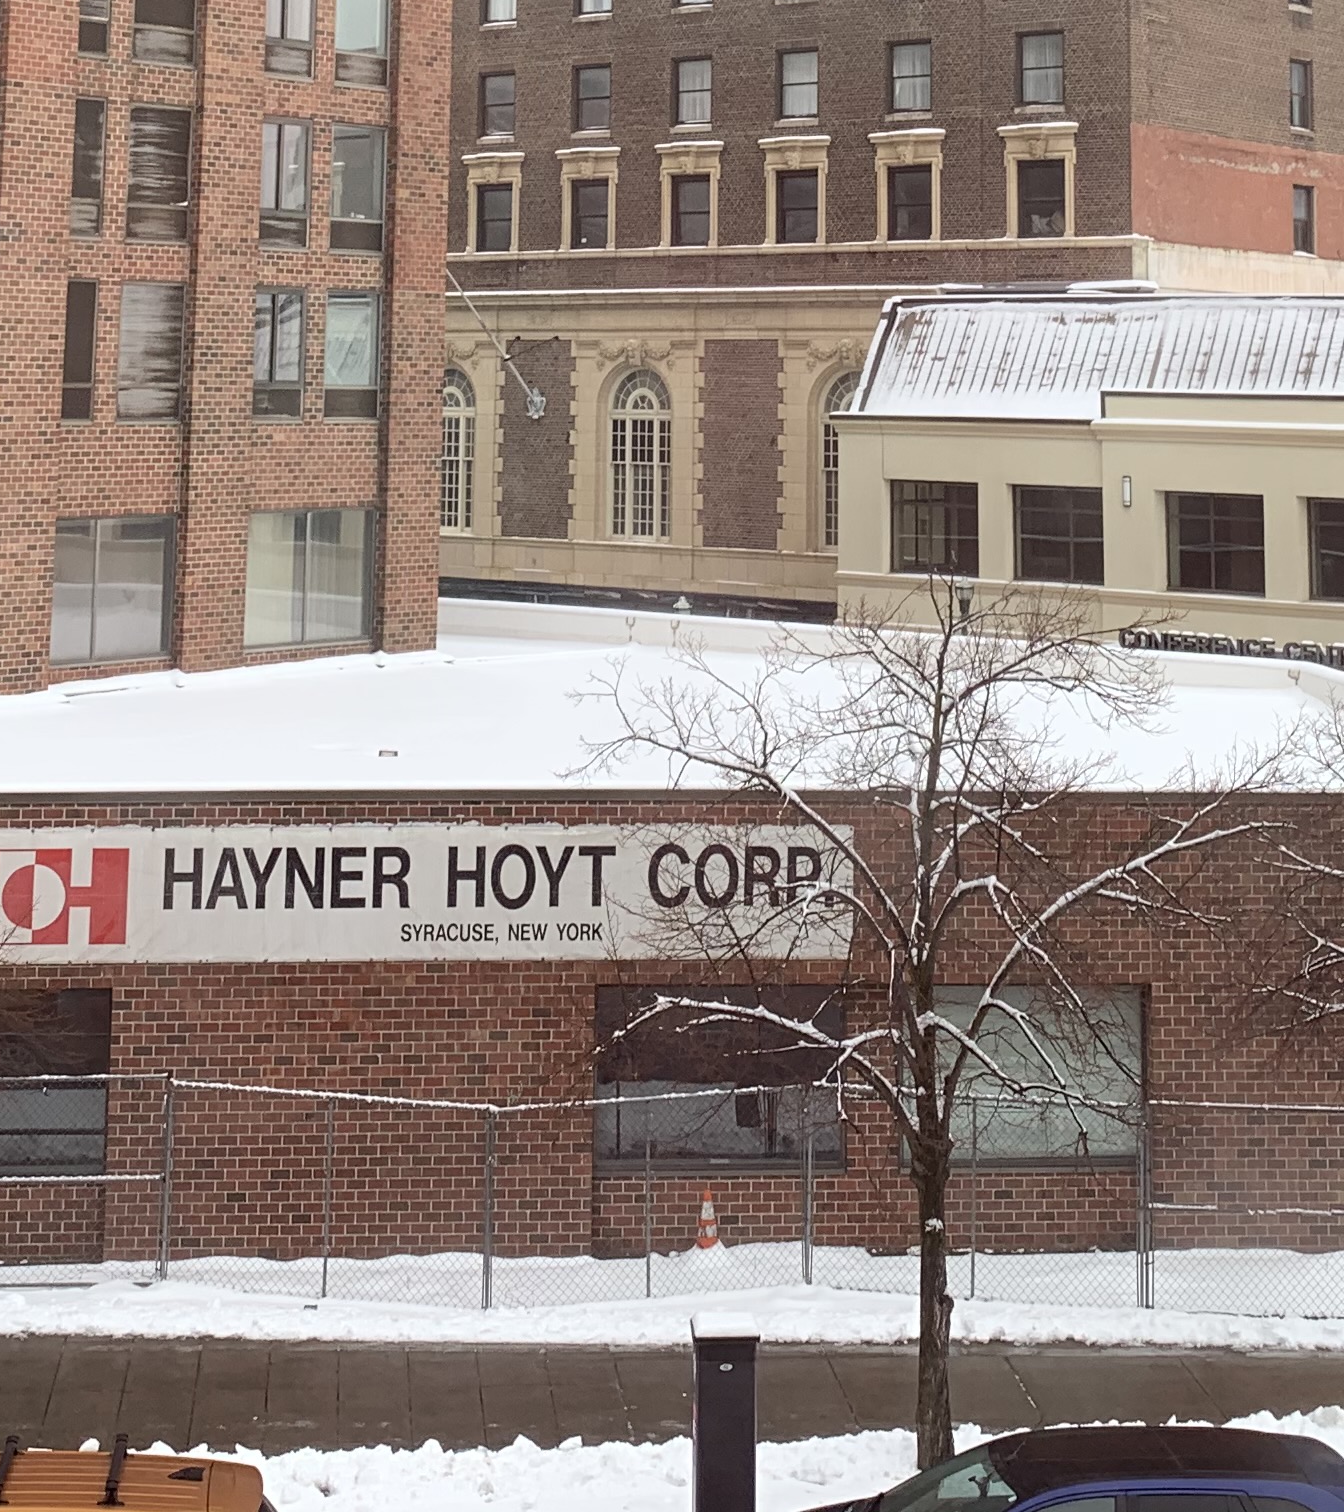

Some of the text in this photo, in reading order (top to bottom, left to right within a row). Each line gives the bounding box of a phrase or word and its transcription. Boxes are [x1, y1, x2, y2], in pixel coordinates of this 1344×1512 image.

[1118, 627, 1275, 657] CONFERENCE
[162, 847, 411, 910] HAYNER
[447, 844, 616, 910] HOYT
[401, 922, 603, 945] SYRACUSE, NEW YORK
